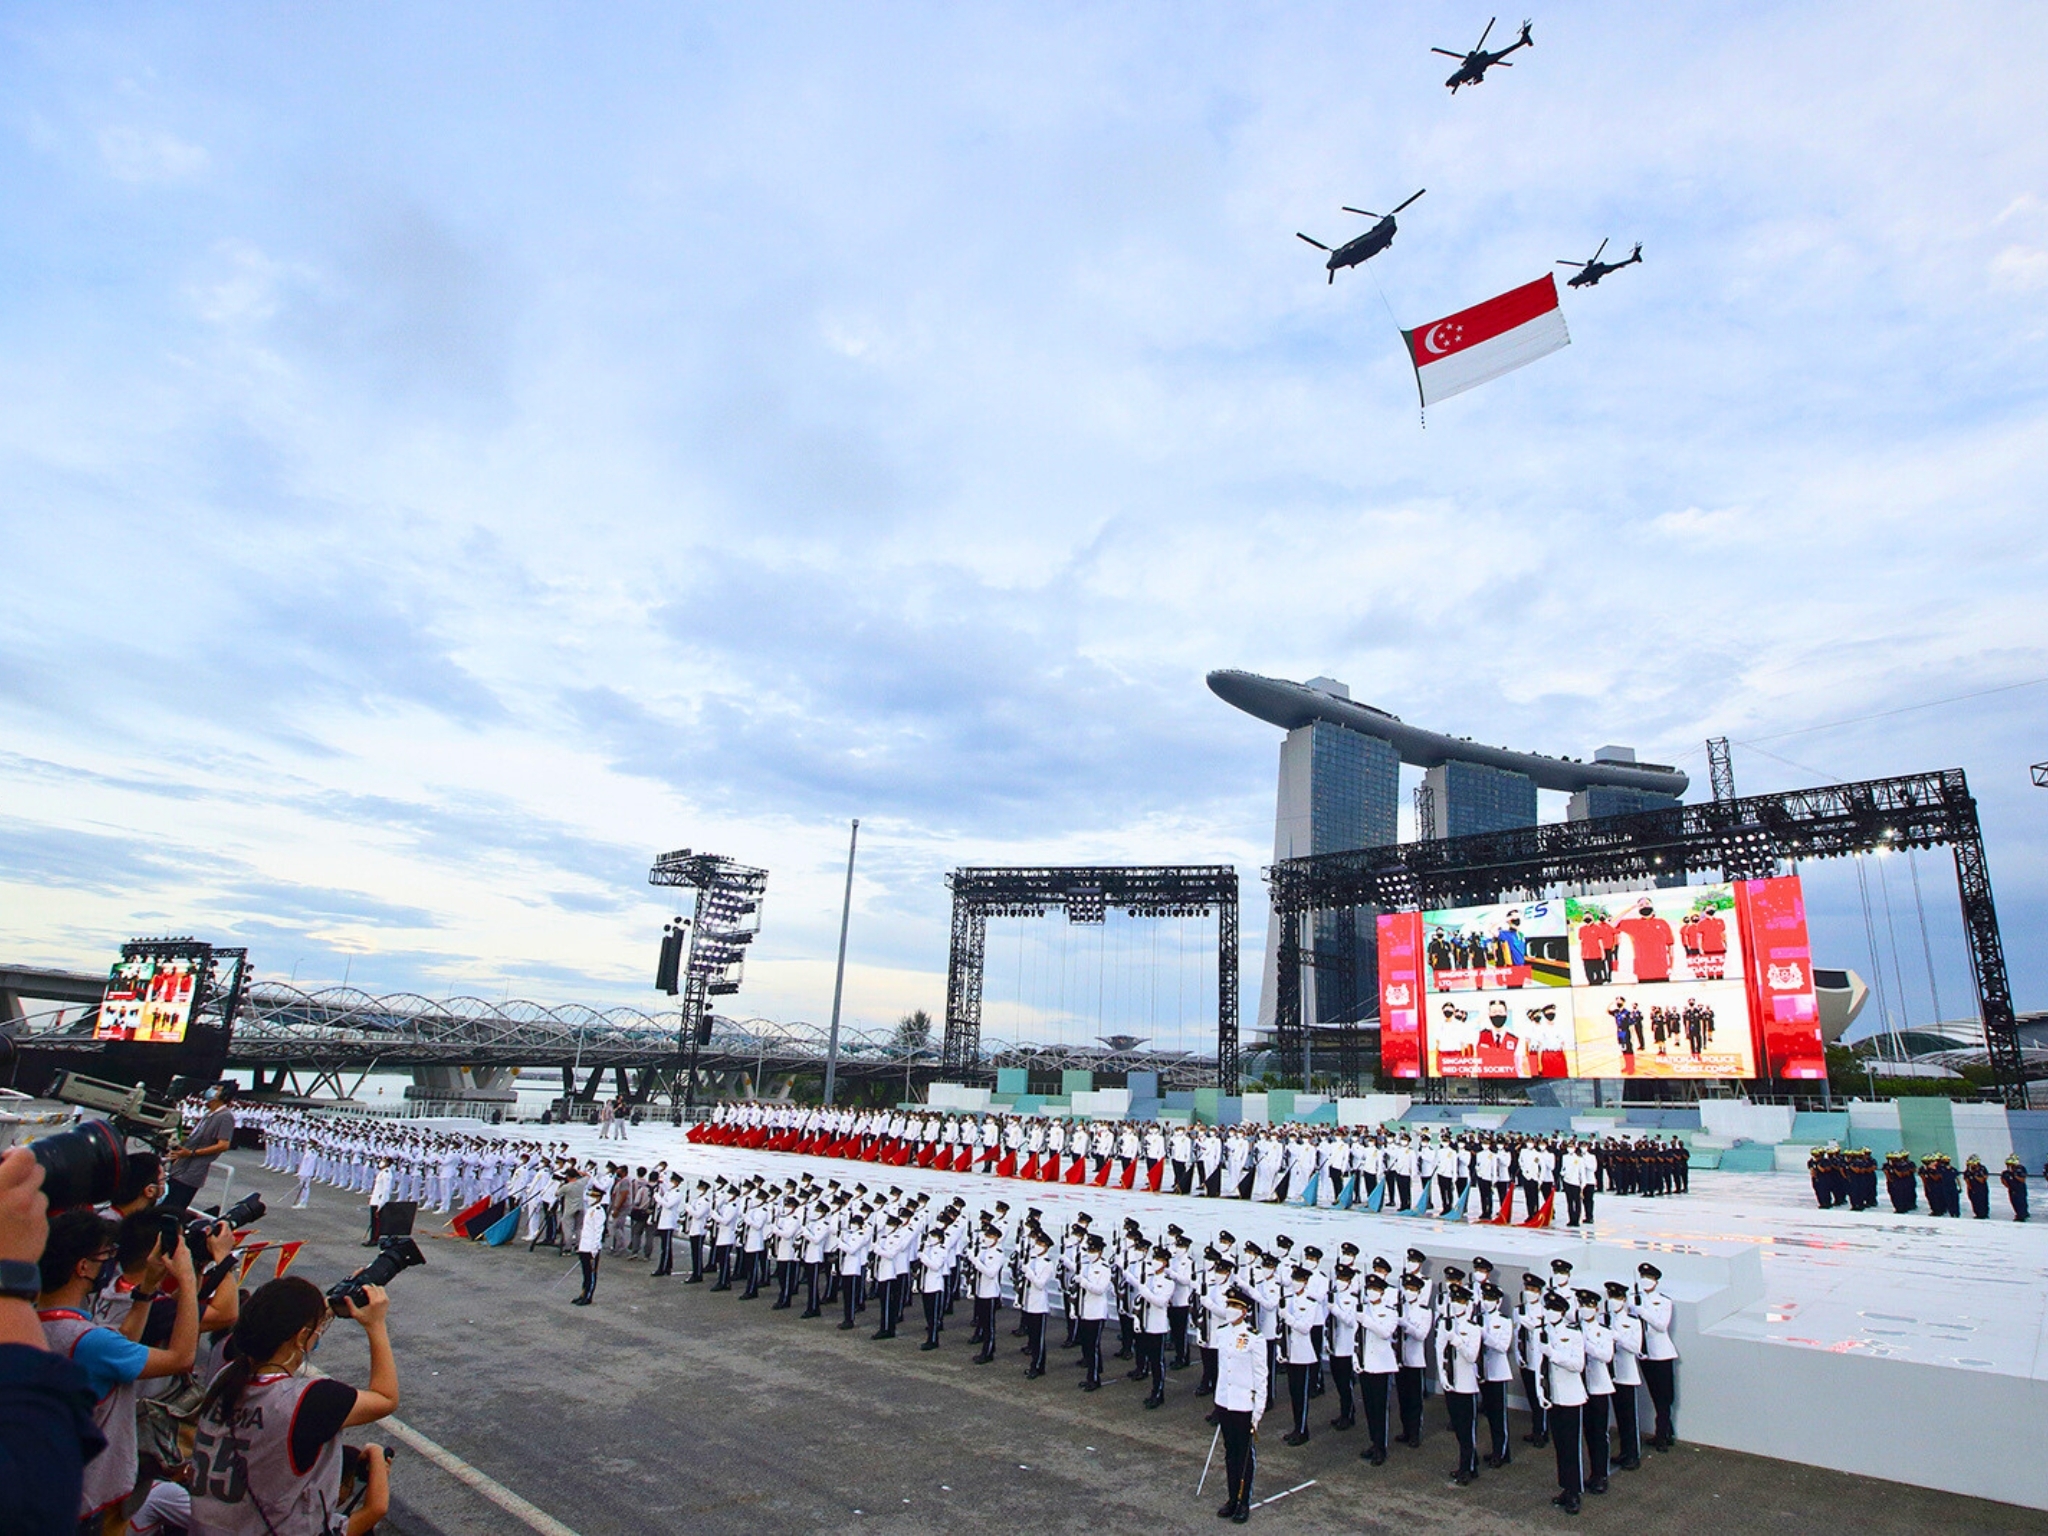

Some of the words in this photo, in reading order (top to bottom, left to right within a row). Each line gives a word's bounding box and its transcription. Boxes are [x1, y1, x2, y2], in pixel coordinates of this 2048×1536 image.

[1442, 1057, 1483, 1065] SINGAPORE
[1702, 1055, 1736, 1063] POLICE
[1442, 1065, 1457, 1073] RED
[1458, 1065, 1483, 1074] CROSS
[1483, 1065, 1515, 1074] SOCIETY
[1705, 1064, 1737, 1073] CORPS
[191, 1430, 251, 1504] 55
